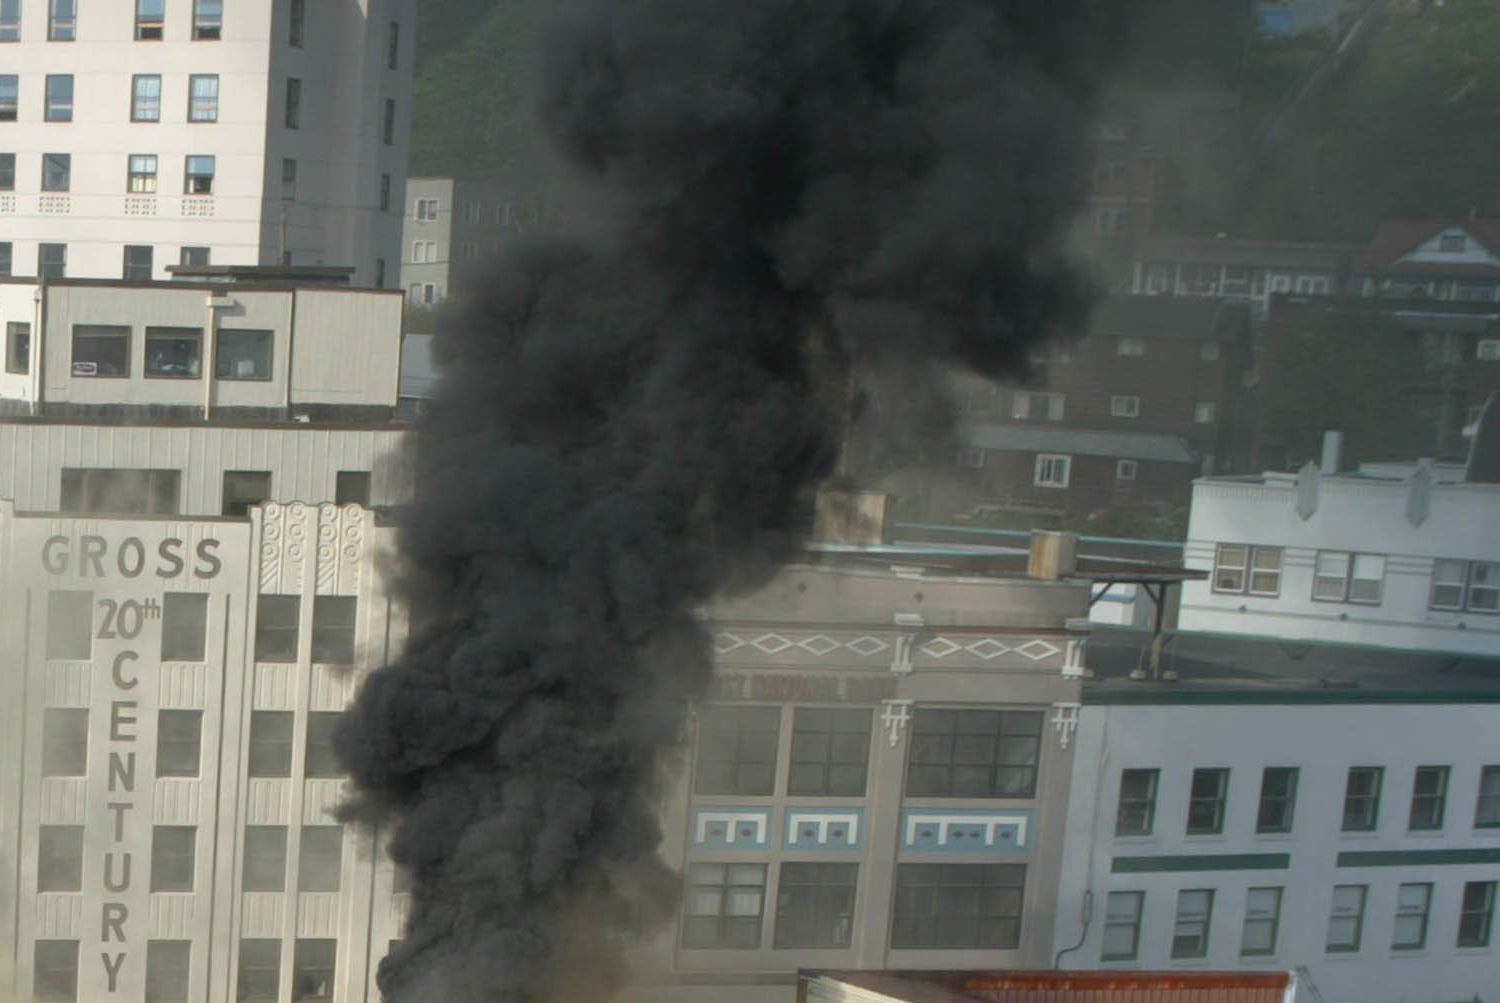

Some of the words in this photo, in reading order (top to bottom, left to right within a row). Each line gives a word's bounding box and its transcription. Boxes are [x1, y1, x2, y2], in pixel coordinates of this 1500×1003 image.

[41, 535, 222, 579] GROSS
[95, 597, 161, 640] 20th
[100, 649, 140, 993] CENTURY
